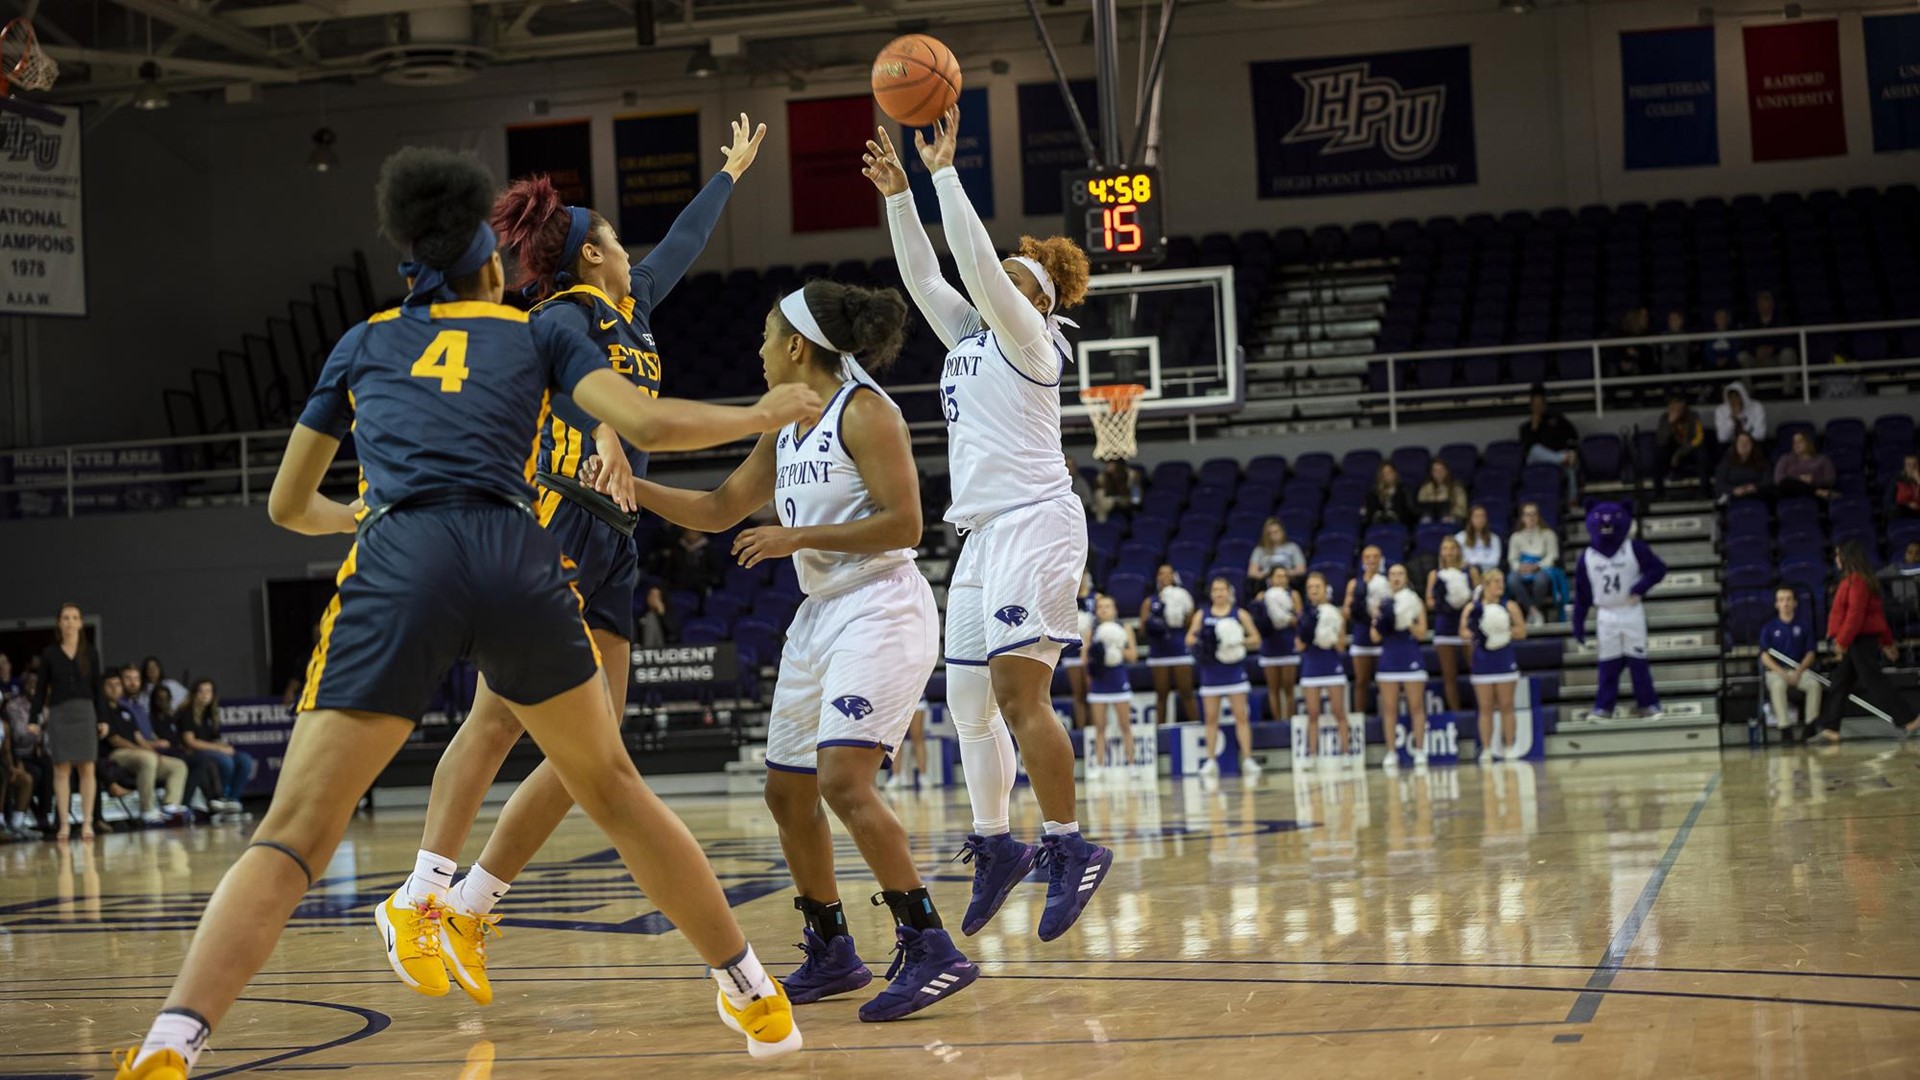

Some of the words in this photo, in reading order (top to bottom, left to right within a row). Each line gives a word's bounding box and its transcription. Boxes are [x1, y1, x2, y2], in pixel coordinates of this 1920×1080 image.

[1763, 71, 1826, 90] RADFORD
[1755, 90, 1835, 110] UNIVERSITY
[1281, 61, 1446, 162] HPU
[1272, 174, 1313, 192] HIGH
[1315, 171, 1361, 188] POINT
[1364, 163, 1457, 185] UNIVERSITY
[1087, 173, 1152, 204] 4:58
[1103, 204, 1142, 252] 15
[11, 258, 46, 278] 1978
[410, 329, 469, 393] 4
[945, 356, 982, 378] POINT
[118, 450, 161, 466] AREA
[787, 461, 833, 487] POINT
[1603, 575, 1621, 594] 24
[631, 646, 717, 665] STUDENT
[635, 664, 714, 684] SEATING
